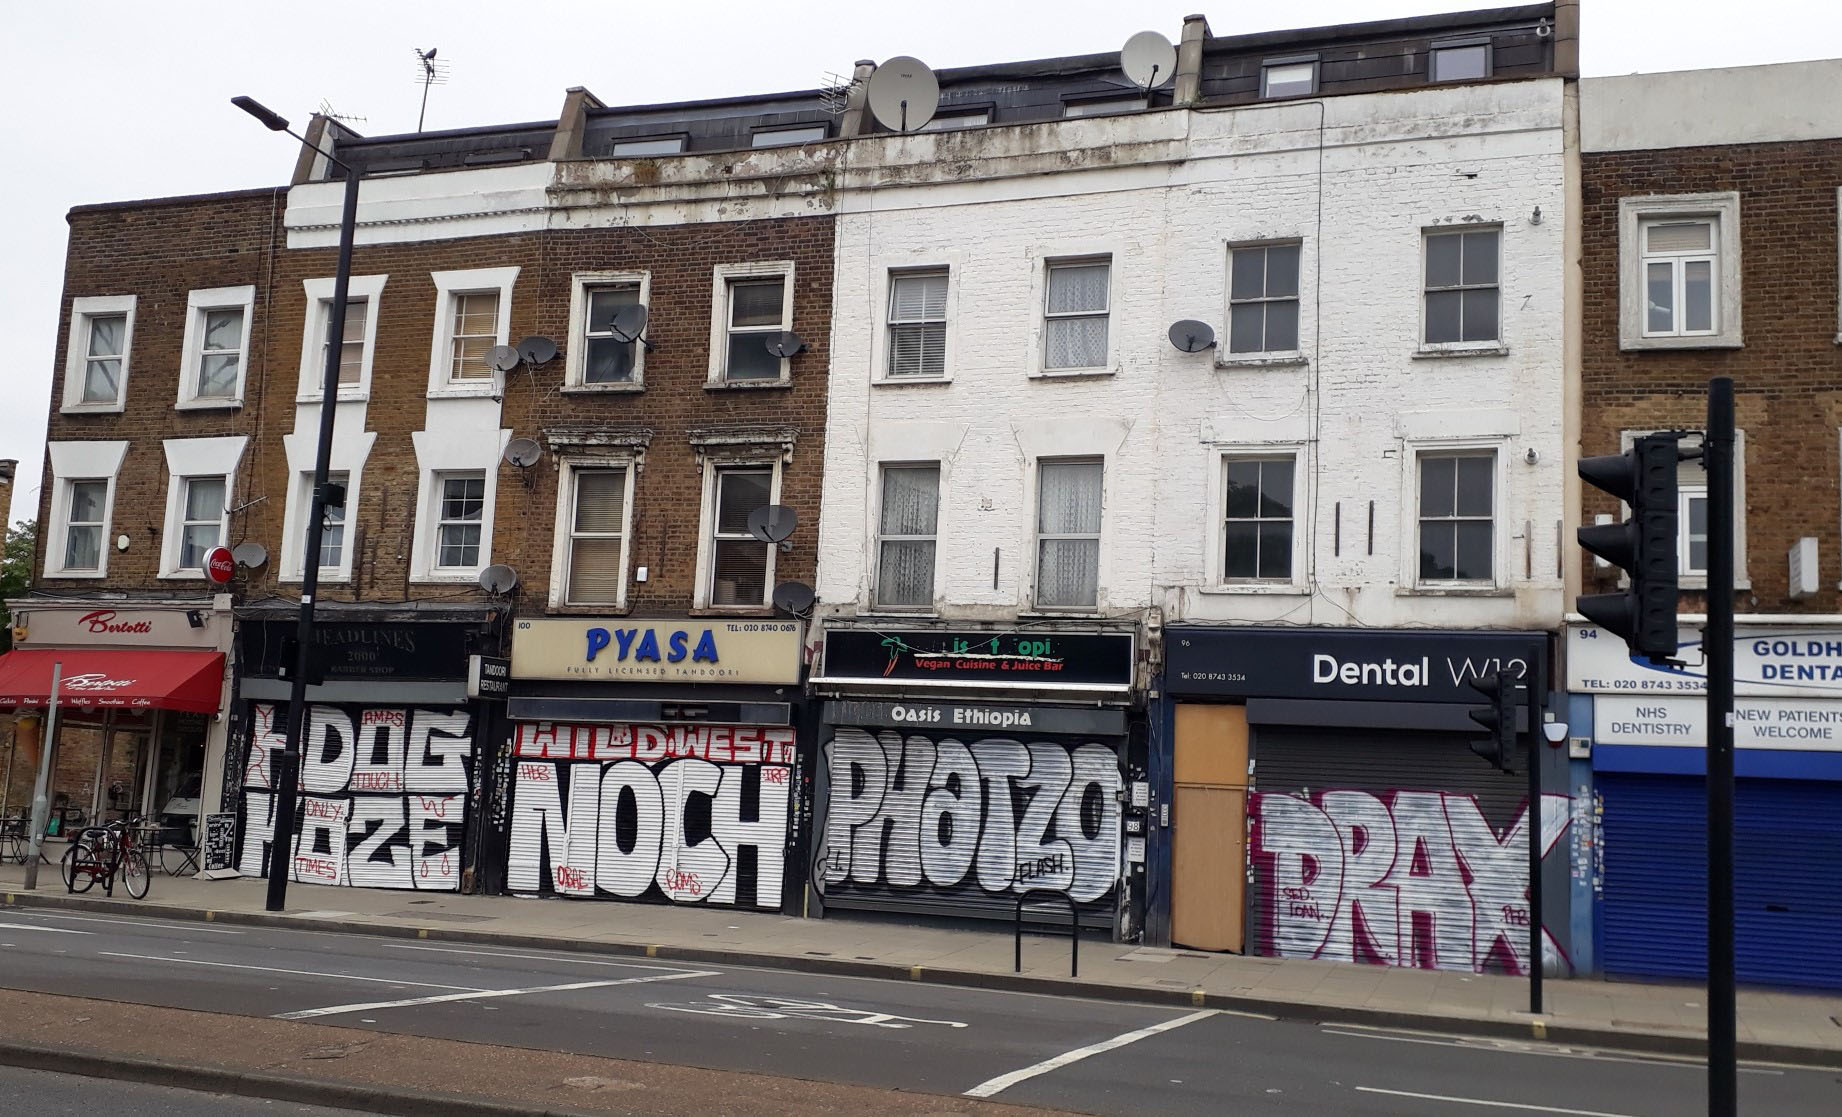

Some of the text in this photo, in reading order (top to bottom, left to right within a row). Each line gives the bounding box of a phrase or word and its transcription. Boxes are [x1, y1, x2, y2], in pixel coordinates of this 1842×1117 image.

[78, 610, 151, 633] Bertotti
[518, 622, 531, 630] 100
[1579, 629, 1598, 639] 94
[586, 626, 719, 664] PYASA
[1181, 639, 1191, 647] 96
[915, 659, 1064, 671] Vegan Cuisine & Juice Bar
[1313, 654, 1430, 687] Dental
[567, 666, 739, 677] FULLY LICENSED TANDOORI
[1193, 672, 1206, 680] 020
[1227, 673, 1246, 681] 3534
[1582, 679, 1707, 690] TEL: 020 8743 3534
[891, 706, 1032, 728] Oasis Ethiopia
[1636, 706, 1667, 719] NHS
[1735, 709, 1771, 721] NEW
[1611, 722, 1692, 735] DENTISTRY
[1753, 725, 1833, 739] WELCOME
[1126, 821, 1140, 831] 98
